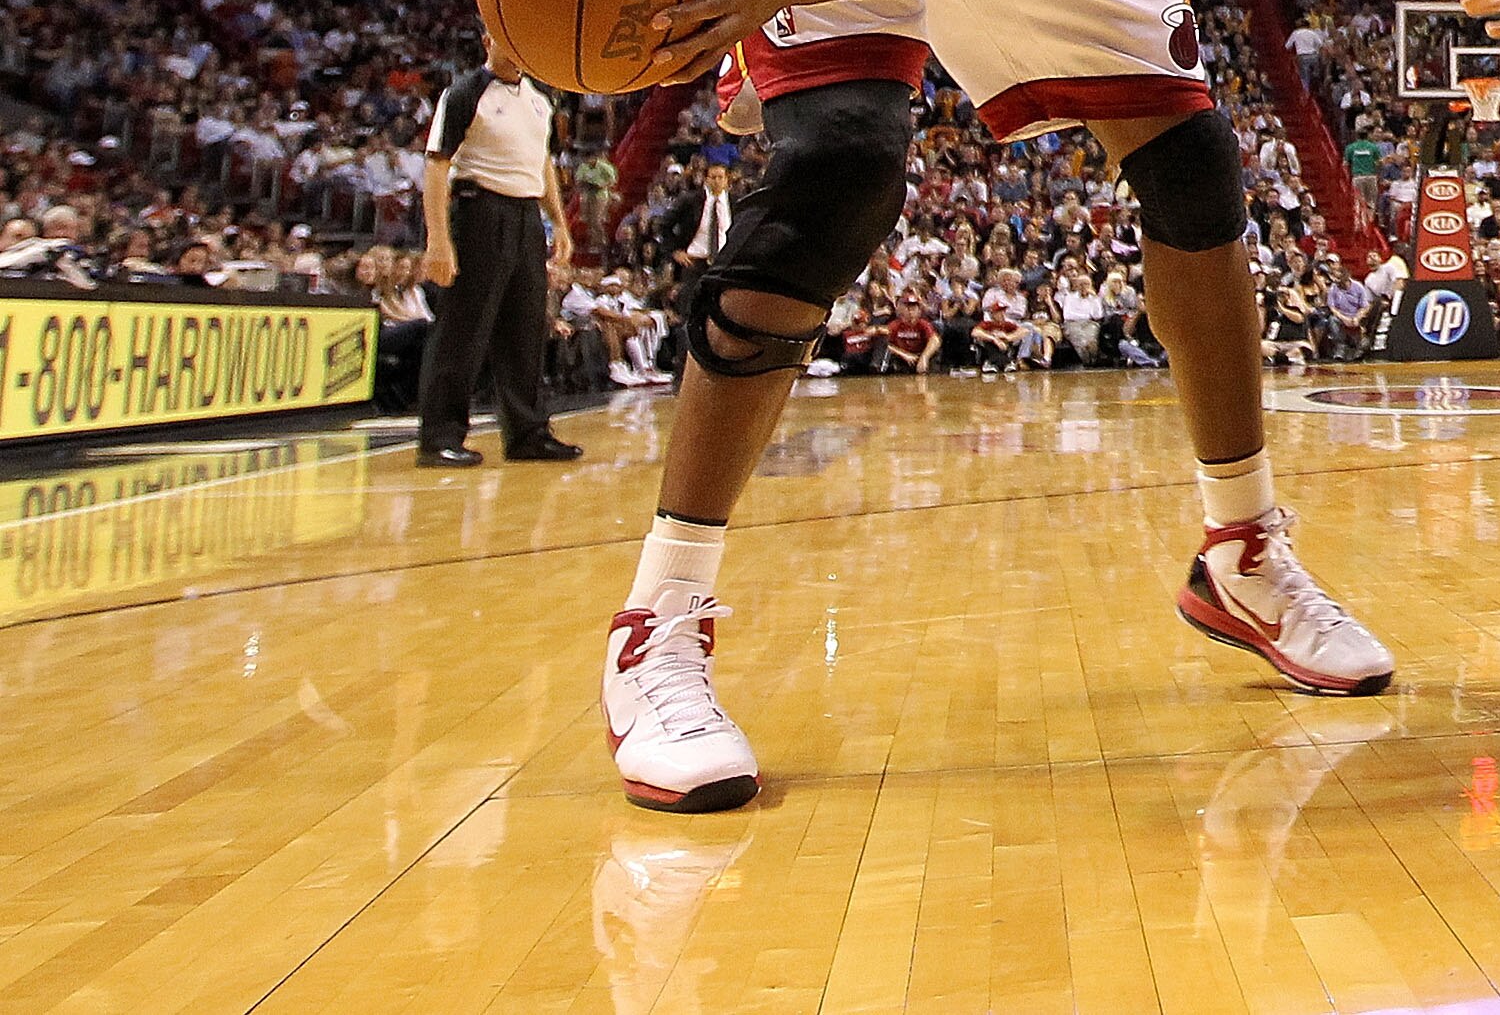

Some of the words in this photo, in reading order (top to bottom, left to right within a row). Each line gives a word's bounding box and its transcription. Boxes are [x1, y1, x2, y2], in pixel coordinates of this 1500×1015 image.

[1431, 184, 1457, 197] KIA
[1430, 216, 1458, 231] KIA
[1428, 252, 1460, 267] KIA
[1423, 290, 1465, 345] hp
